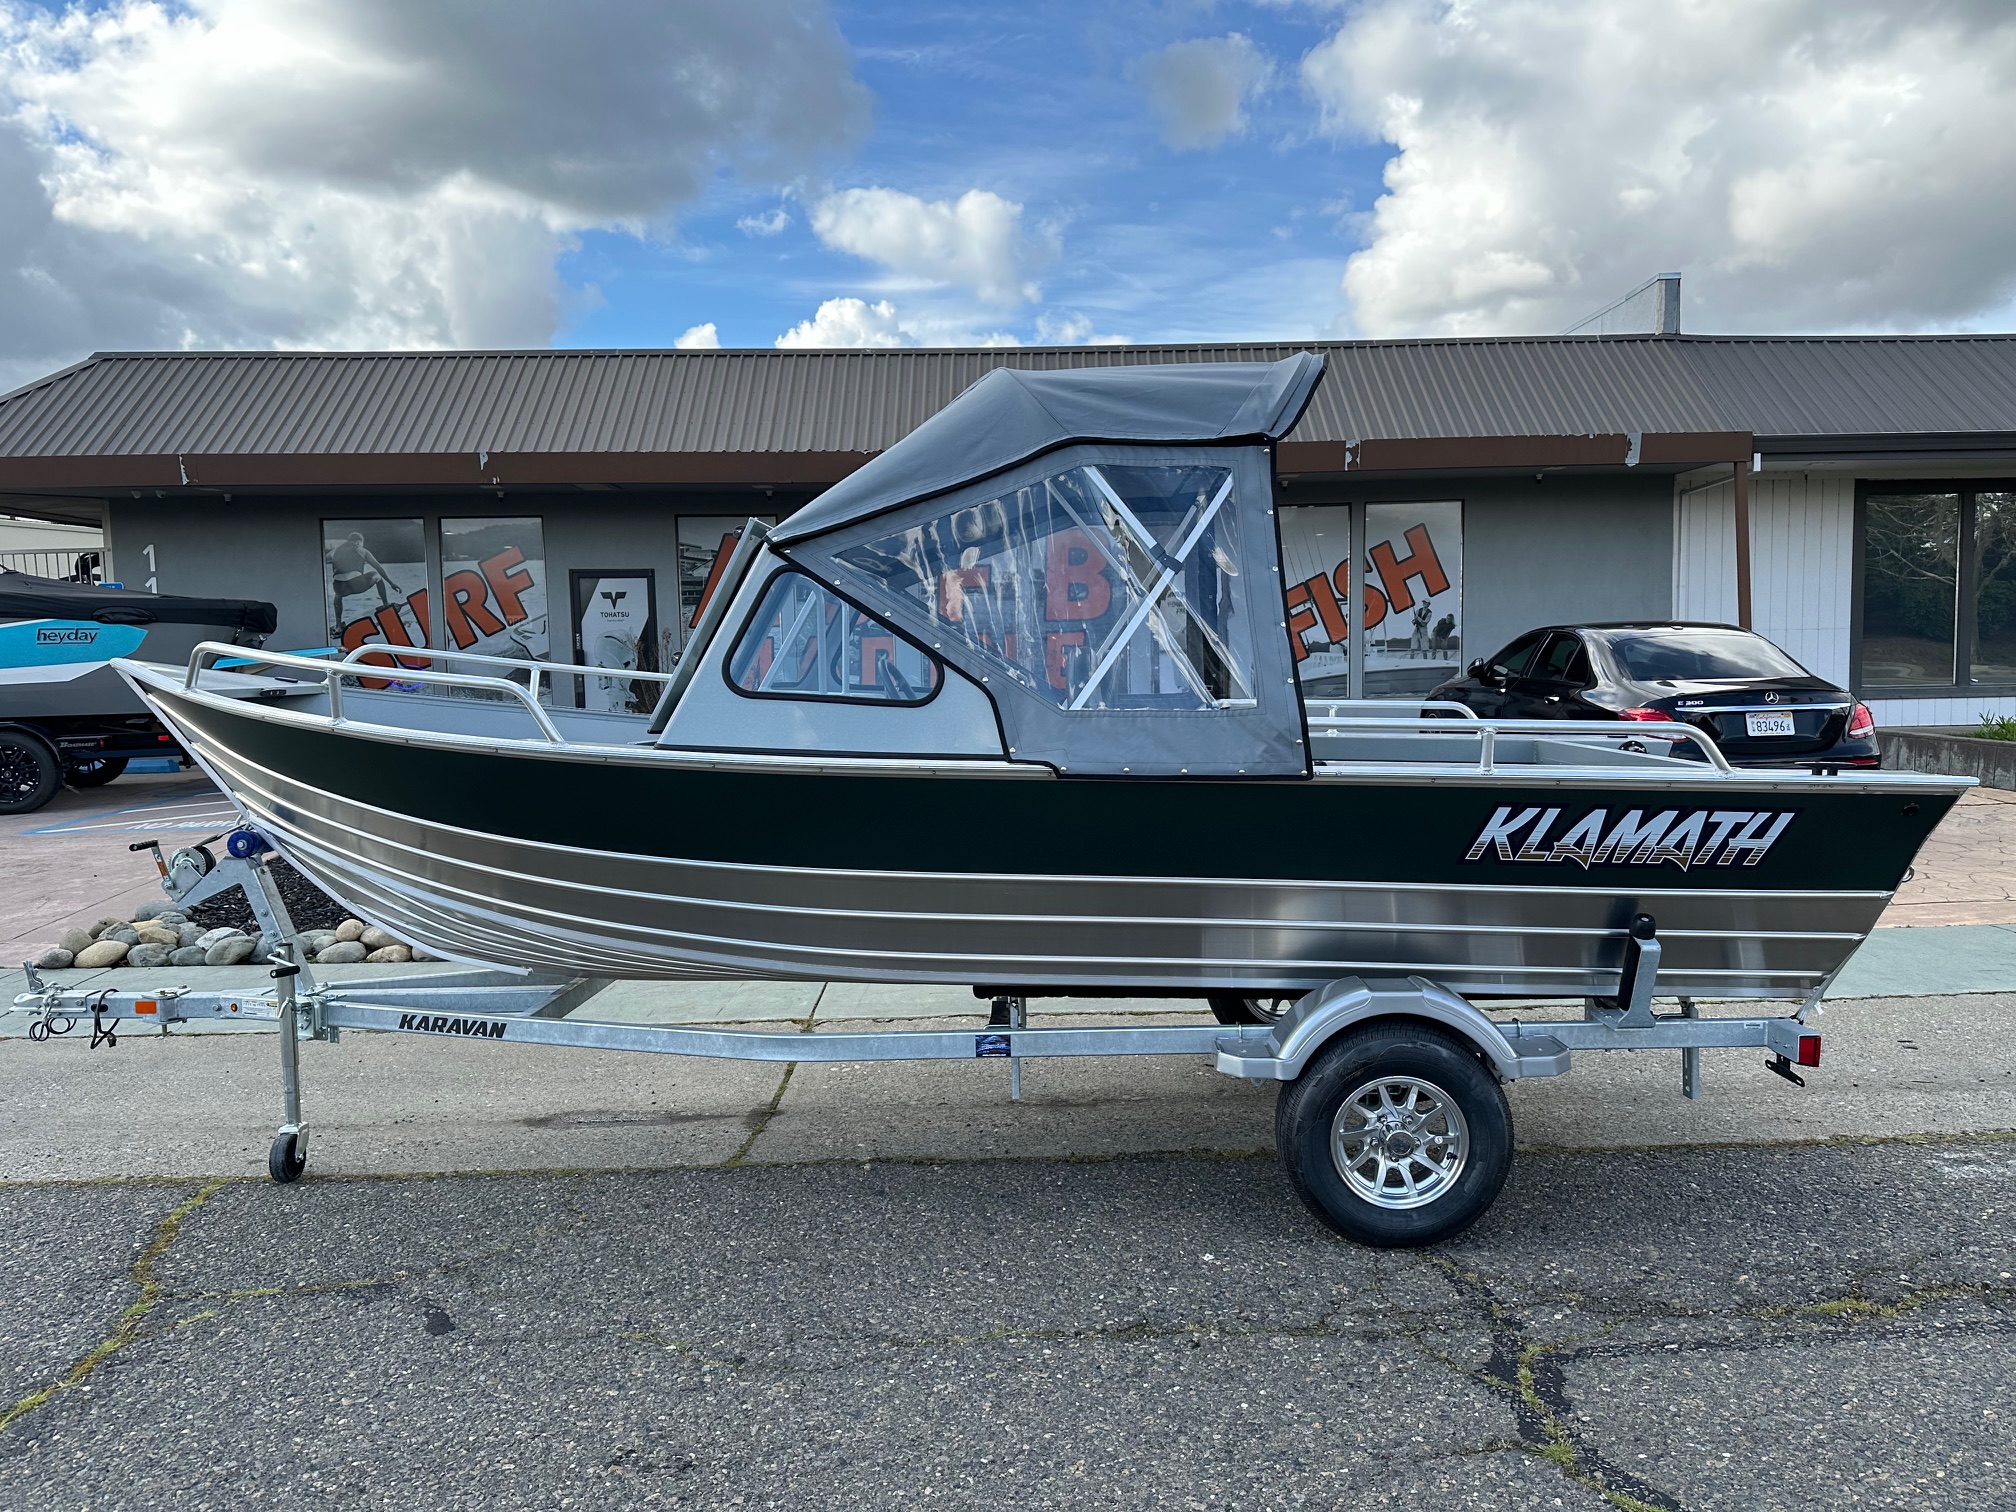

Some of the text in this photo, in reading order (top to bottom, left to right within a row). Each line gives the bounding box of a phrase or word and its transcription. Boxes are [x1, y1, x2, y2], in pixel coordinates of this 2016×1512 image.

[1286, 522, 1451, 663] FISH
[36, 628, 100, 645] heyday
[341, 545, 535, 690] SURF
[1756, 720, 1786, 732] 83496
[1463, 806, 1796, 872] KLAMATH
[398, 1013, 508, 1039] KARAVAN
